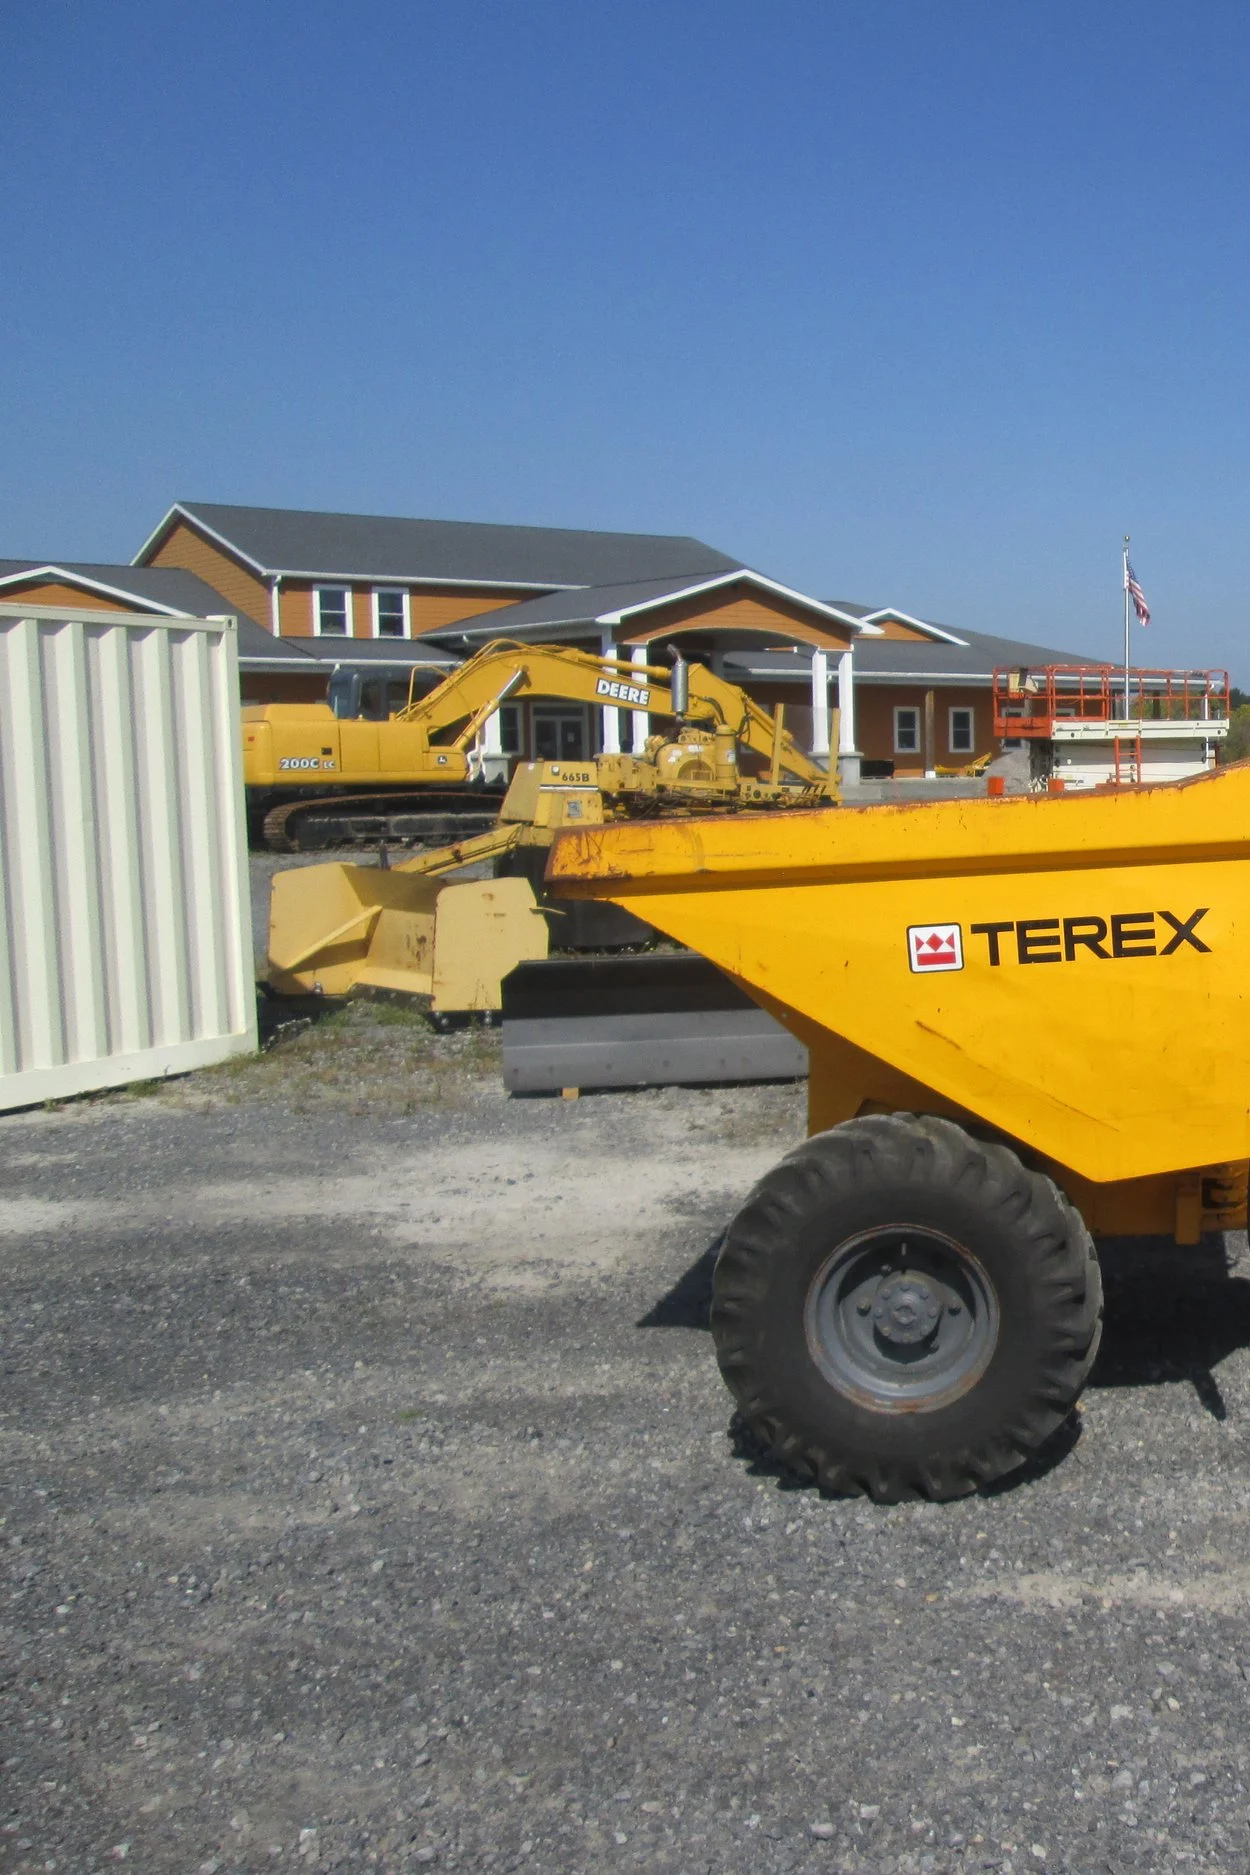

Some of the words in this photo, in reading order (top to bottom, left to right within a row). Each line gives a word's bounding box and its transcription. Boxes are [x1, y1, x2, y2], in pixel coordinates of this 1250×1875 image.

[597, 679, 650, 705] DEERE
[279, 757, 320, 769] 200C
[562, 773, 590, 782] 665B
[970, 908, 1213, 967] TEREX
